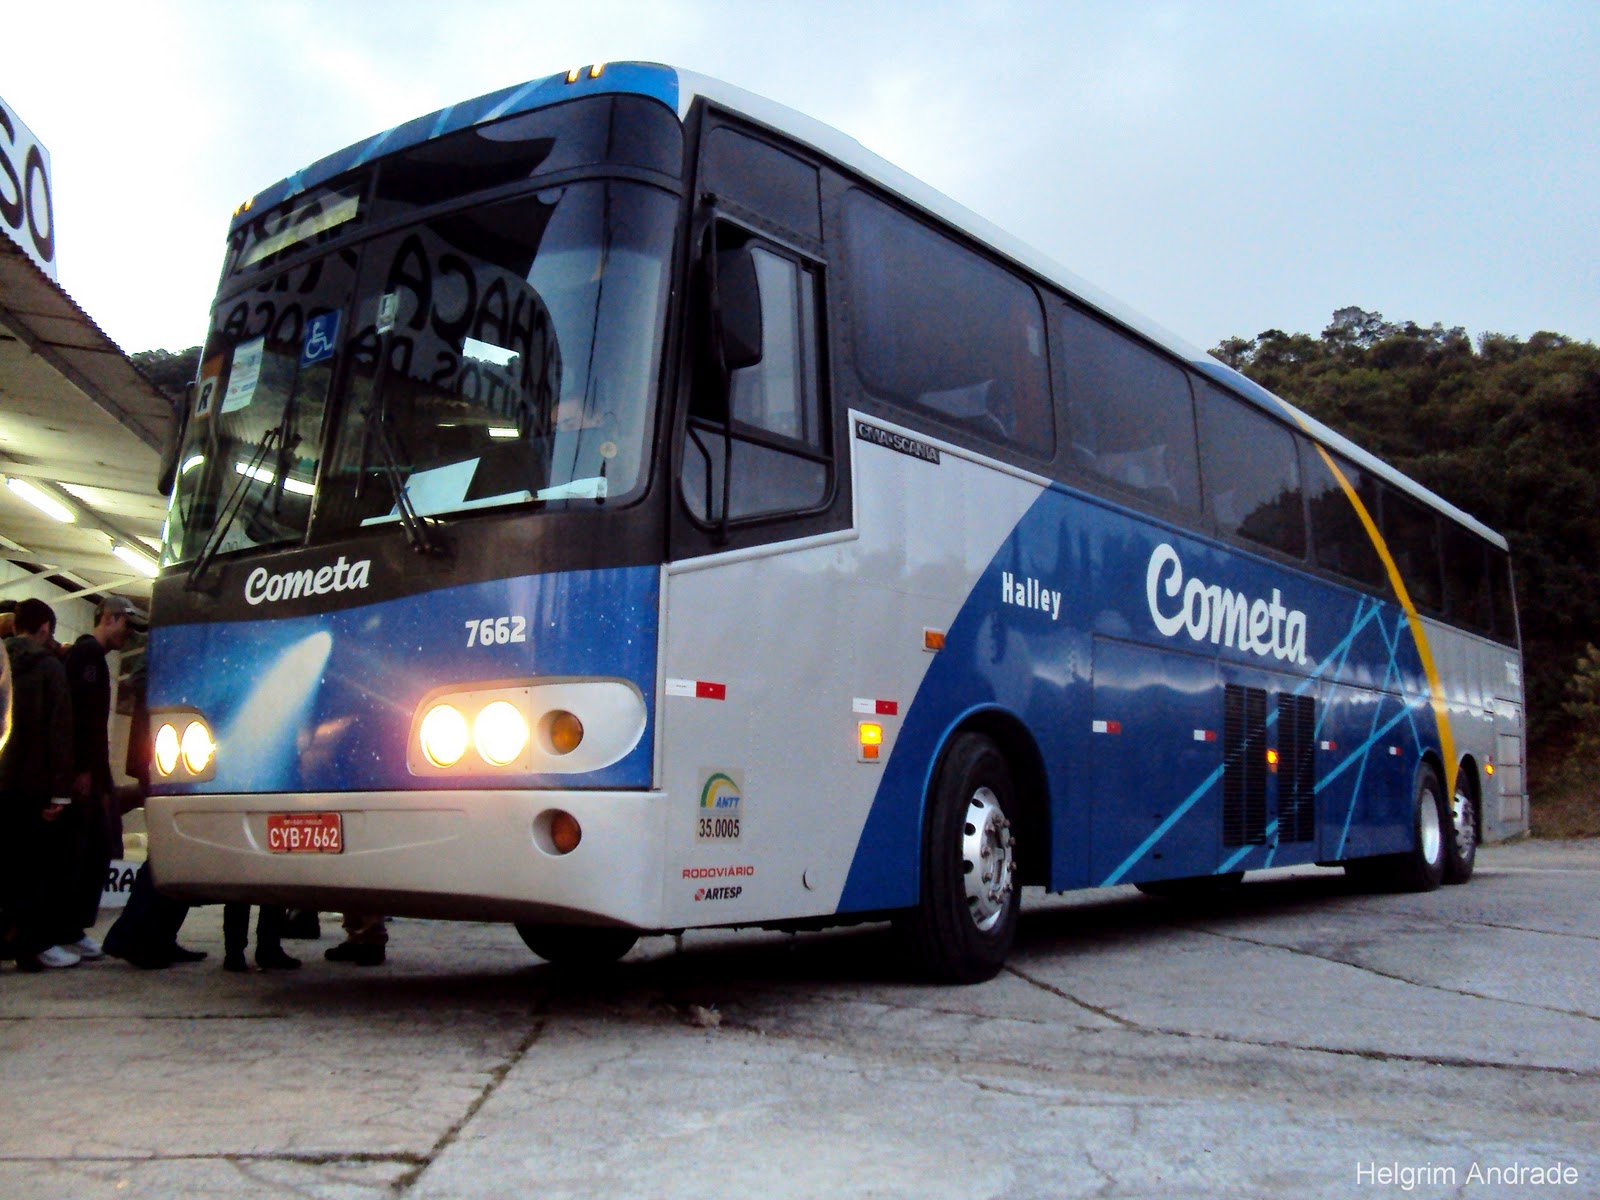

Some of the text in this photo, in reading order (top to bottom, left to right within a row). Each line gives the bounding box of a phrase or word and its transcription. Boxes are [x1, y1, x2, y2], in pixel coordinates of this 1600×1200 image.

[245, 556, 371, 605] Cometa
[1002, 571, 1061, 620] Halley
[1146, 543, 1307, 665] Cometa
[465, 615, 526, 647] 7662
[716, 796, 740, 808] ANTT
[699, 818, 740, 838] 35.0005
[705, 886, 742, 900] ARTESP
